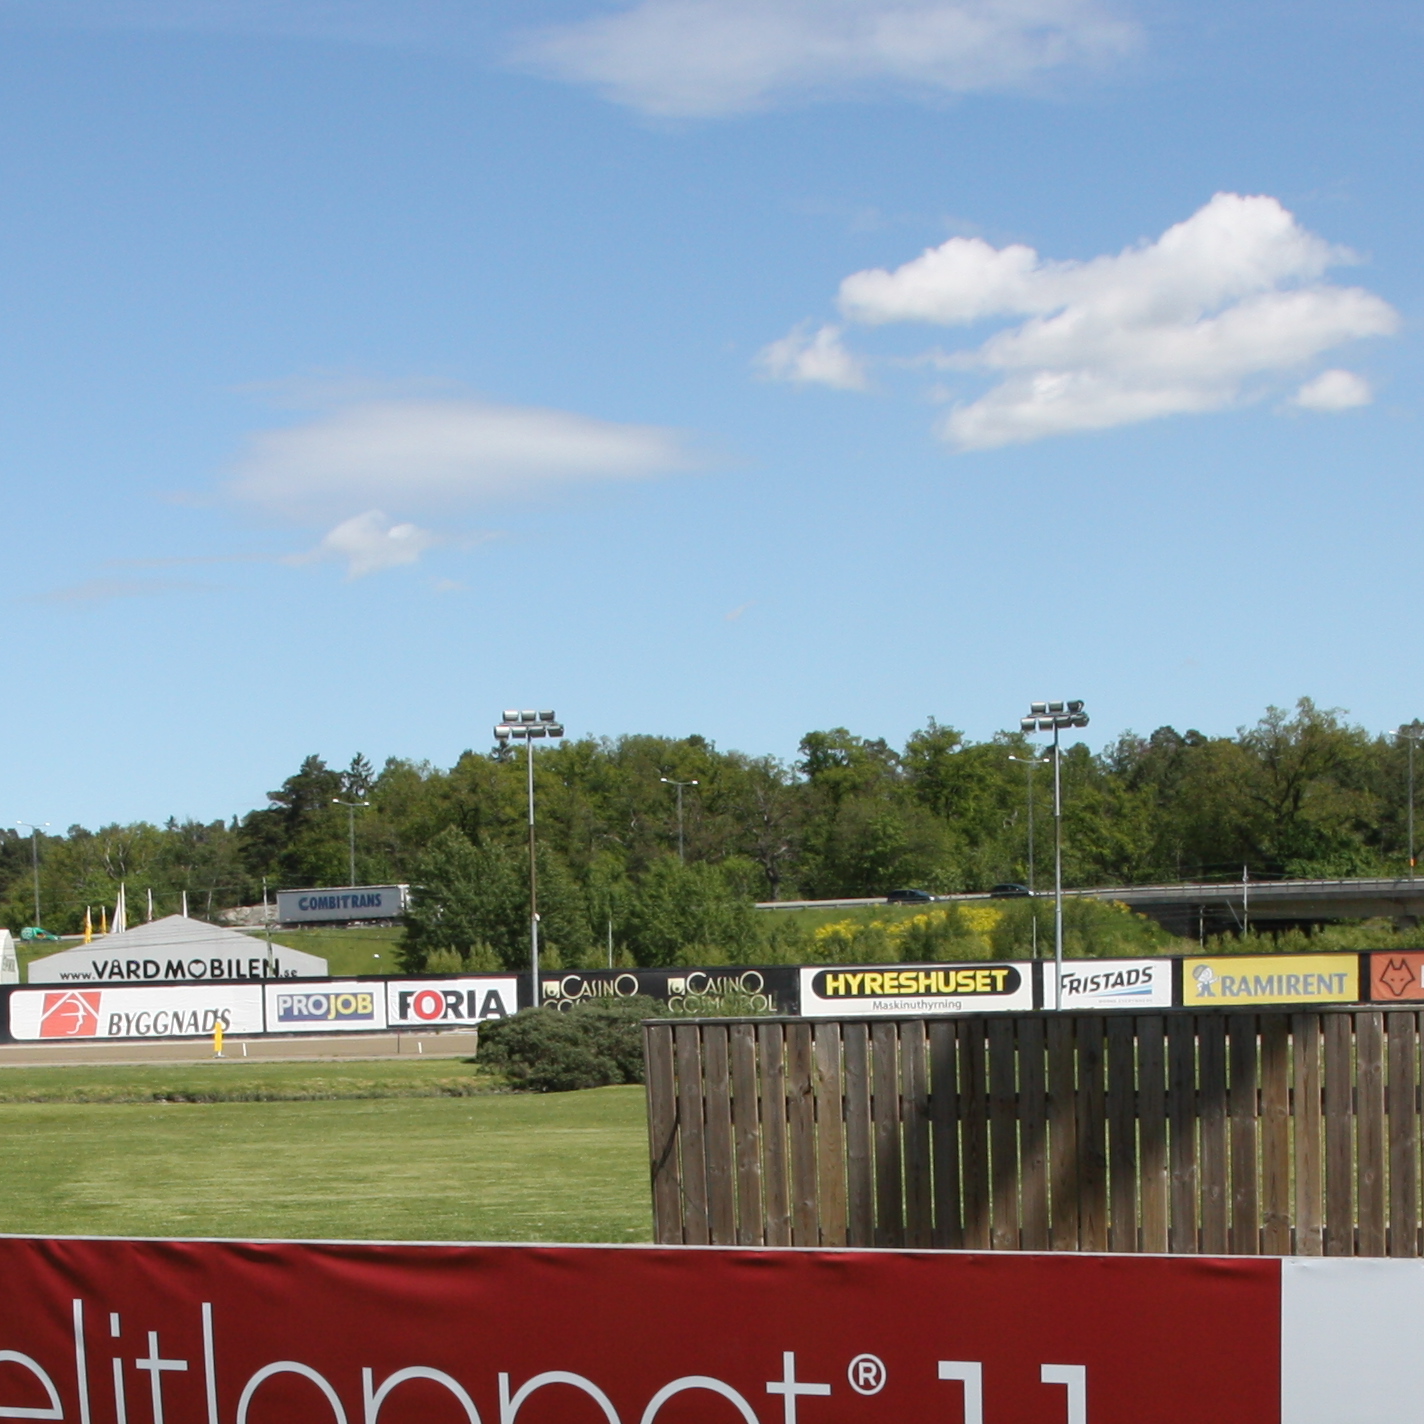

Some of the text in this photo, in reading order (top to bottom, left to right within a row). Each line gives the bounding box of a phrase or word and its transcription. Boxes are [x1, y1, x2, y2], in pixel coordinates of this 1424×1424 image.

[298, 894, 381, 911] COMBITRANS
[825, 969, 1009, 996] HYRESHUSET
[1061, 965, 1153, 996] FRISTADS
[1220, 972, 1348, 998] RAMIRENT
[278, 994, 374, 1020] PROJOB
[398, 989, 507, 1020] FORIA
[872, 998, 962, 1011] Maskinuthyrning
